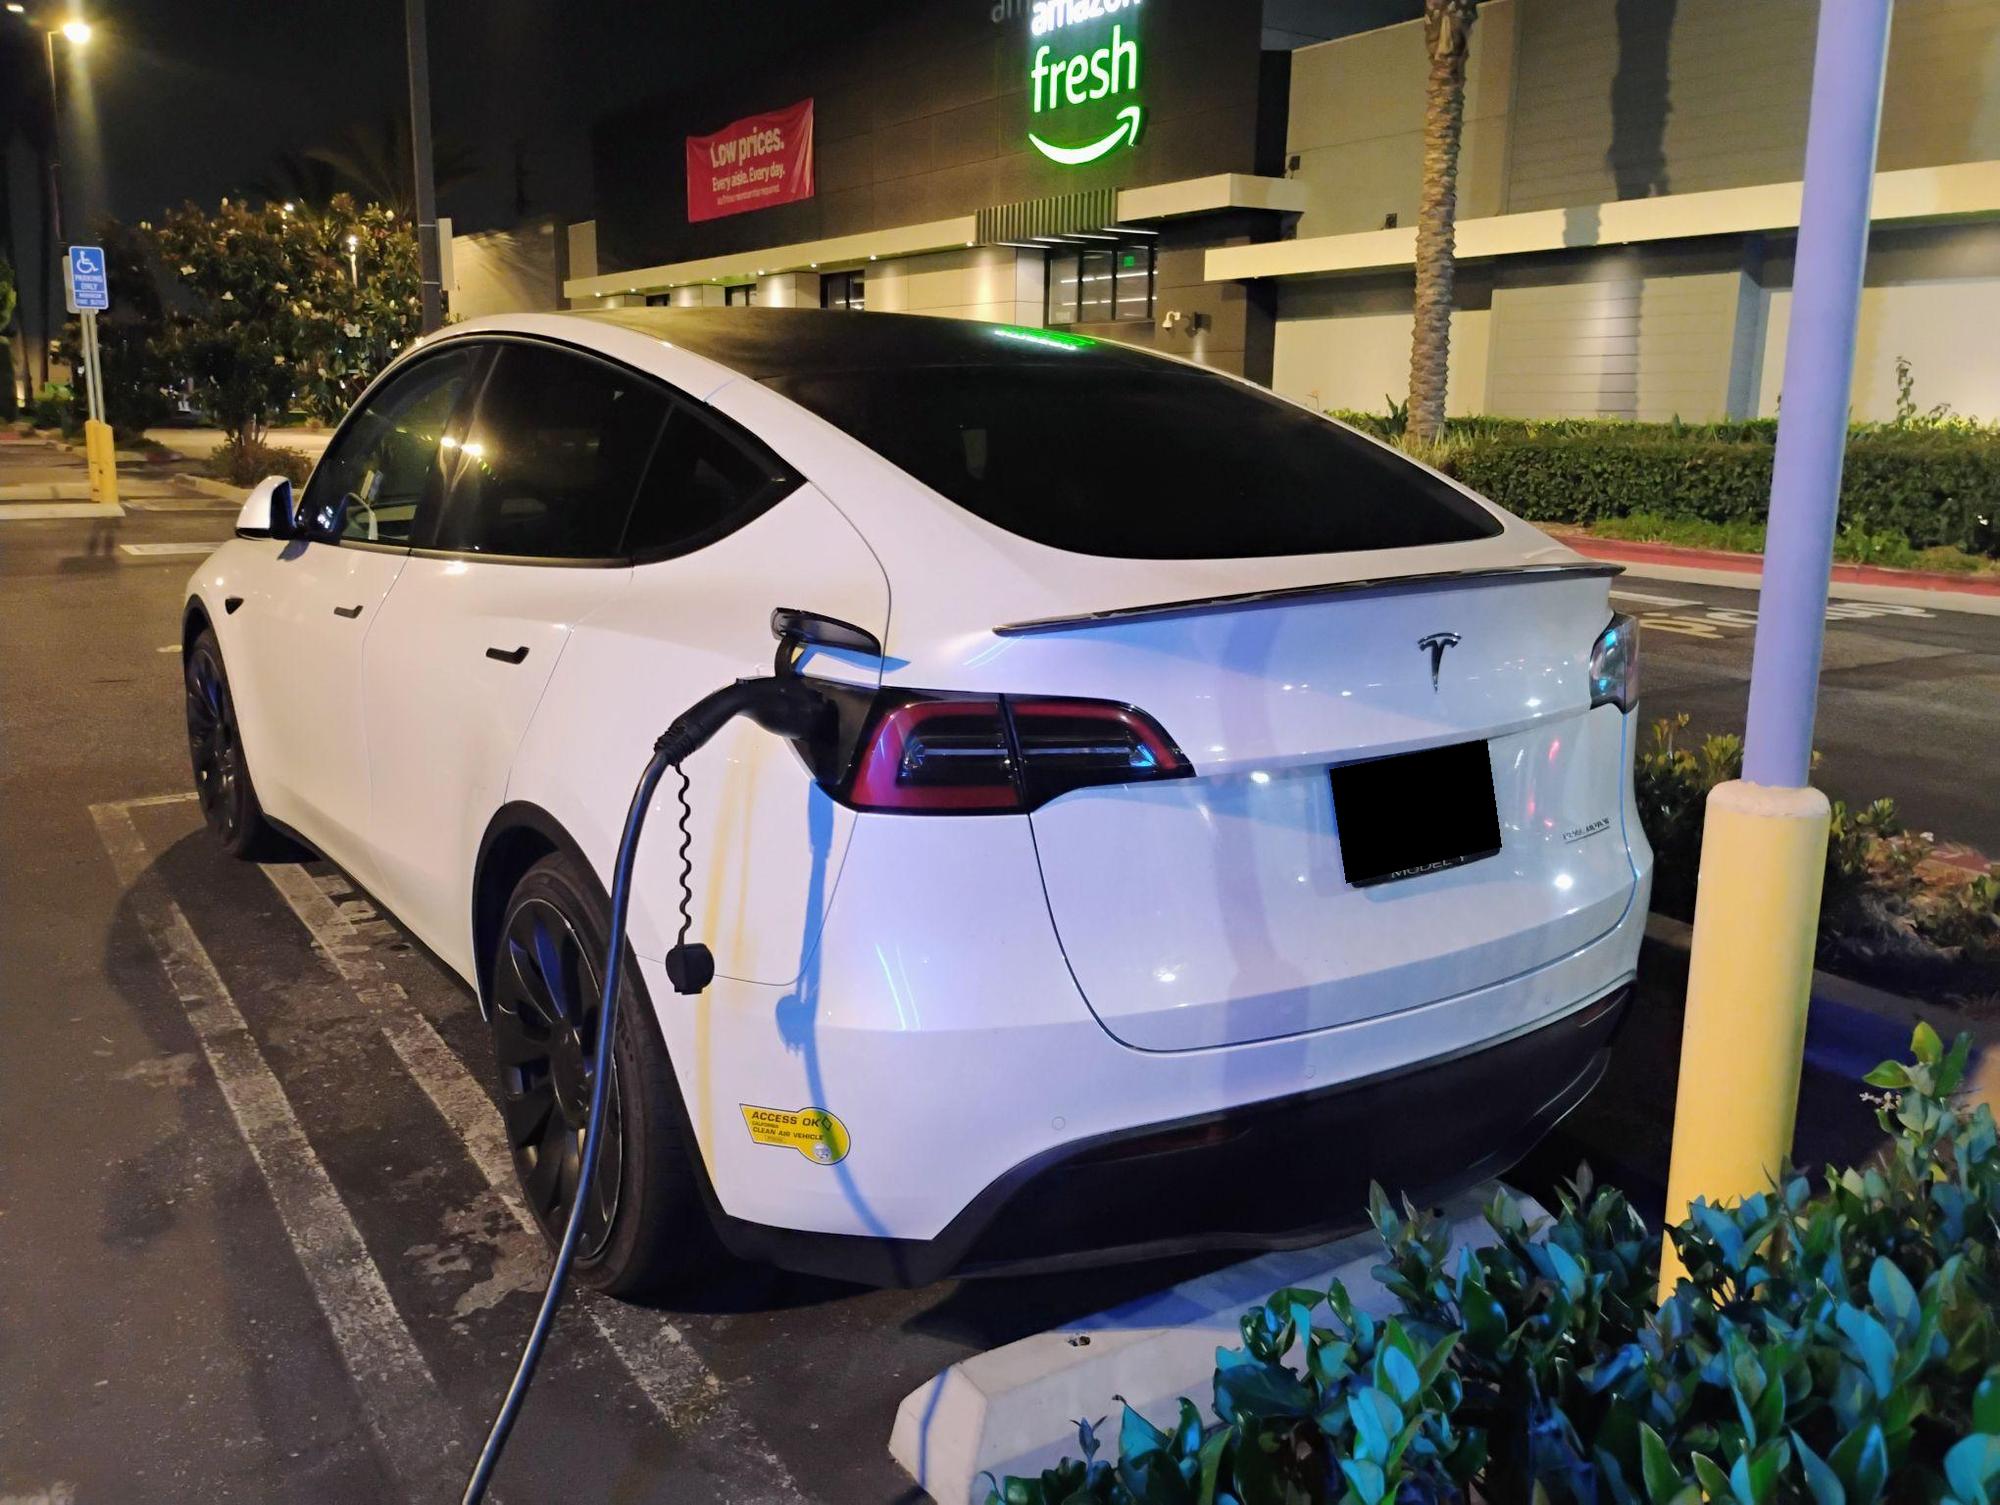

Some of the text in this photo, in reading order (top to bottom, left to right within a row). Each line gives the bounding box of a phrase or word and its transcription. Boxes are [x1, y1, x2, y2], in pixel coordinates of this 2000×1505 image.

[1031, 0, 1141, 36] amaz
[1031, 24, 1137, 113] fresh
[710, 126, 785, 168] Low prices.
[749, 166, 769, 182] Every
[751, 1111, 820, 1127] ACCESS OK
[752, 1126, 776, 1135] CLEAN
[793, 1132, 824, 1141] VEHICLE
